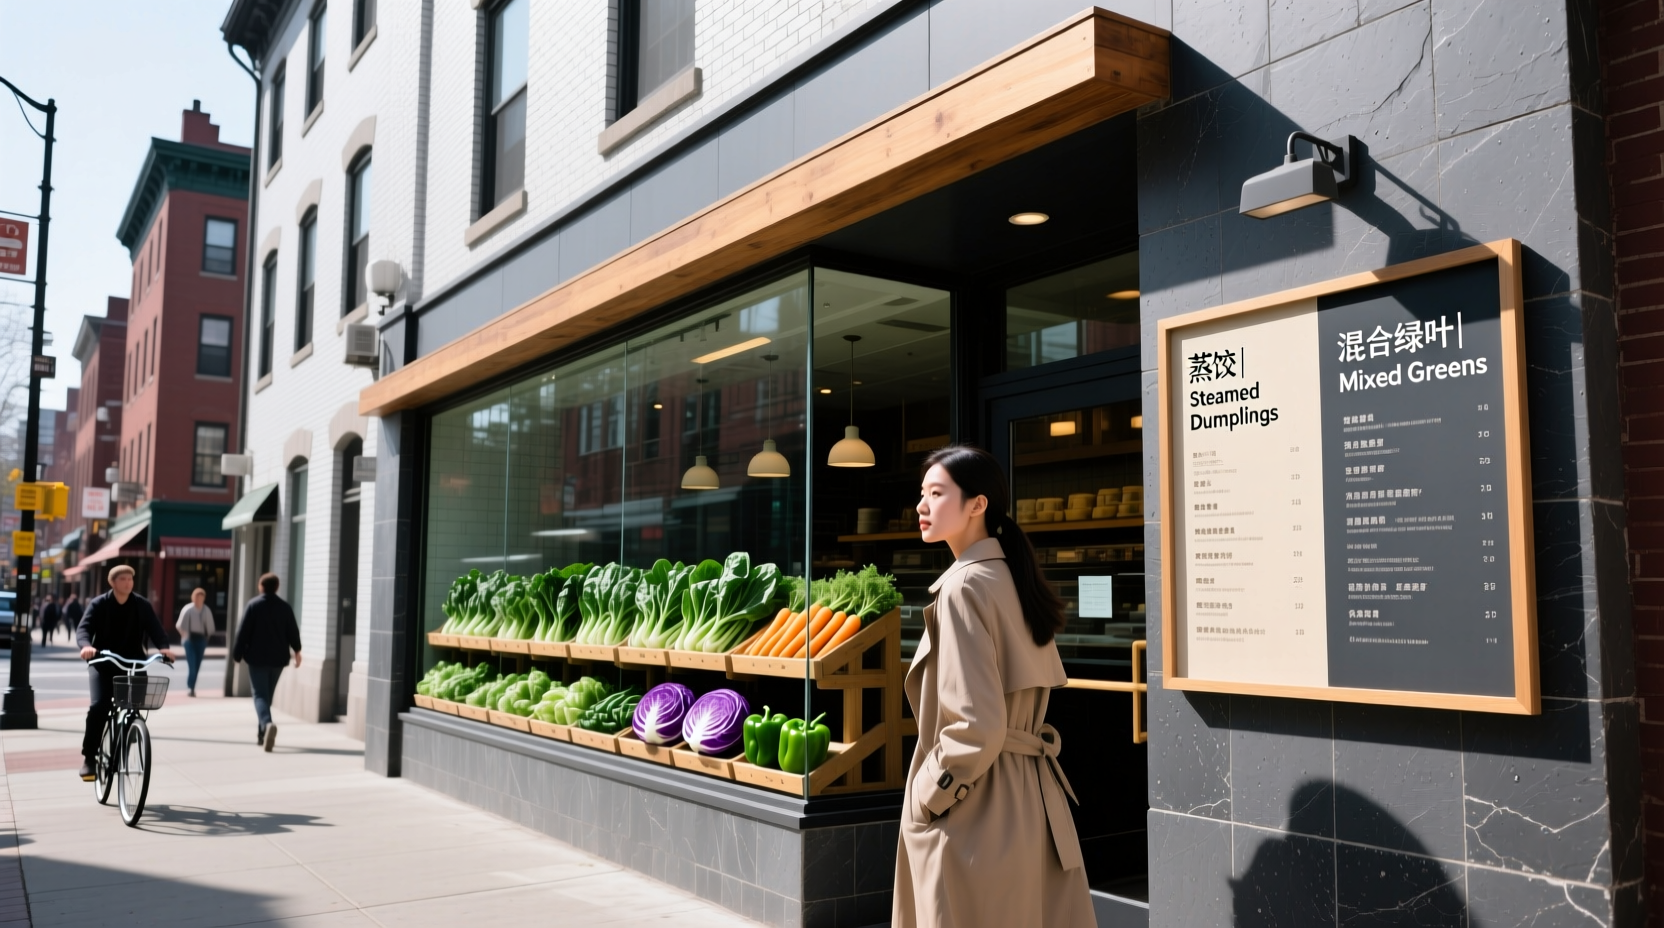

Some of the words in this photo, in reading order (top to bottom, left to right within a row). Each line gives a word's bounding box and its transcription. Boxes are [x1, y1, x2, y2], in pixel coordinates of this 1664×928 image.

[1339, 363, 1402, 393] Mixed
[1407, 357, 1488, 383] Greens
[1190, 381, 1260, 407] Steamed
[1191, 406, 1279, 432] Dumplings
